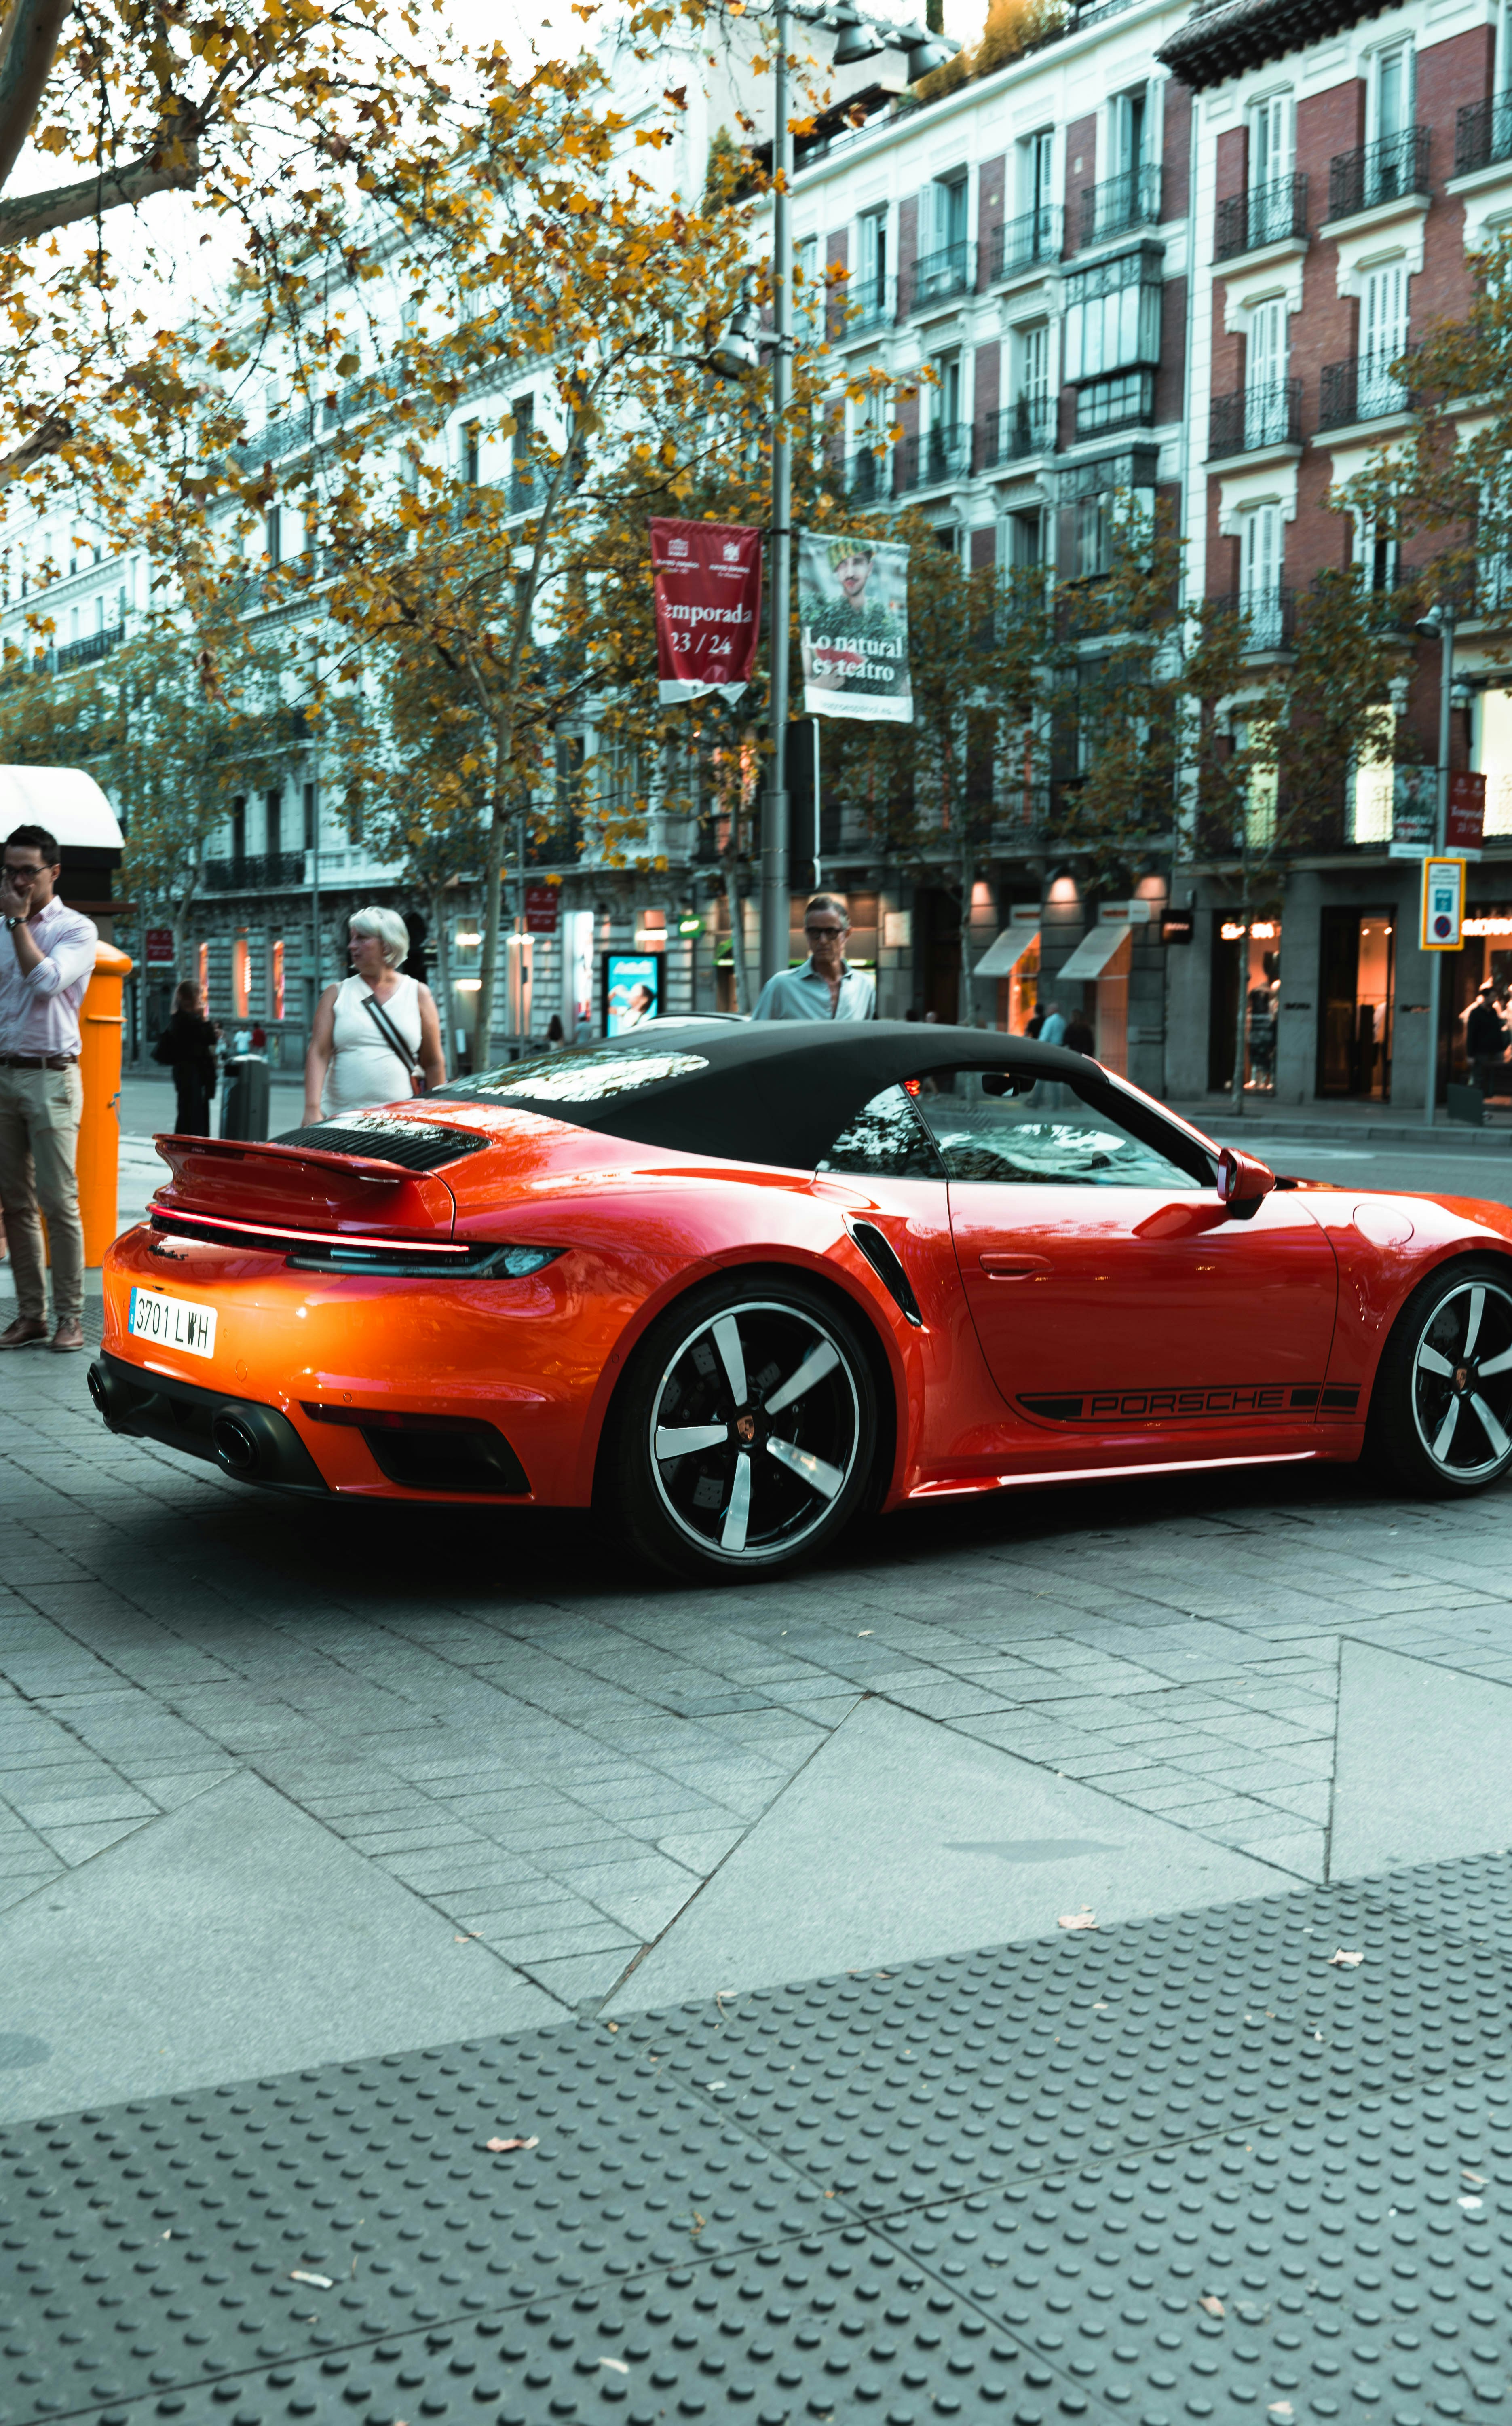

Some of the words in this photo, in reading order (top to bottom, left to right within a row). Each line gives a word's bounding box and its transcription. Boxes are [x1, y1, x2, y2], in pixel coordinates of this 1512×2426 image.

[661, 594, 752, 627] emporada
[708, 634, 733, 655] 24
[803, 626, 832, 650] Lo
[834, 636, 903, 659] natural
[813, 658, 833, 675] es
[836, 659, 895, 682] teatro
[137, 1298, 169, 1338] 3701
[175, 1308, 208, 1349] LWH
[1090, 1390, 1285, 1416] PORSCHE
